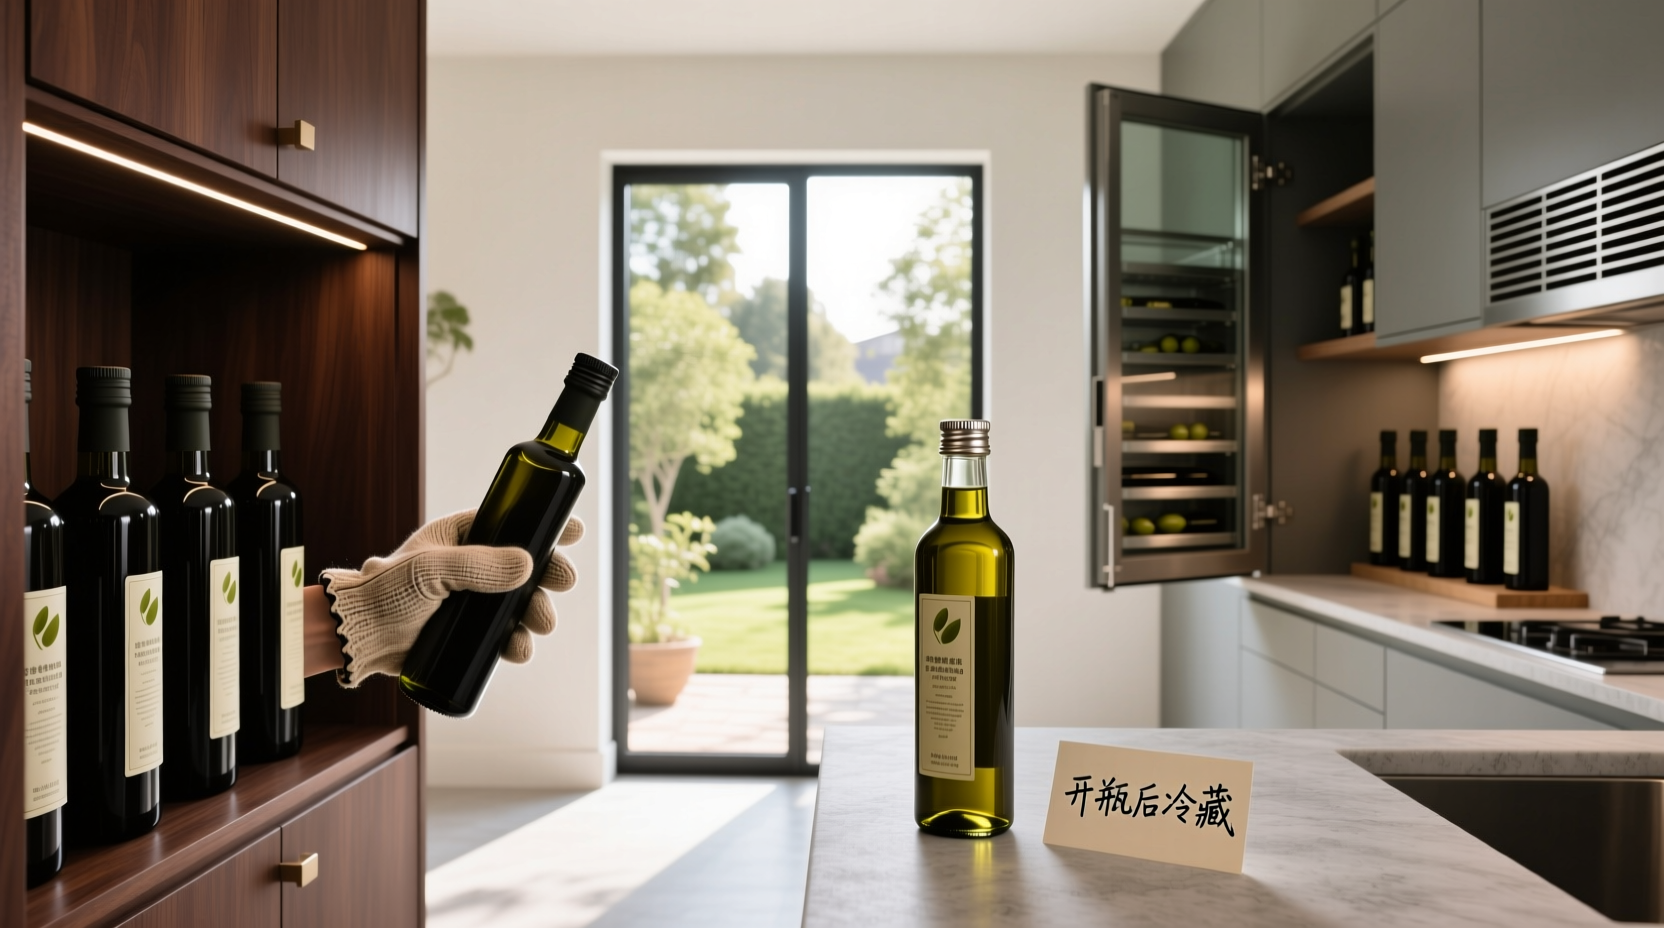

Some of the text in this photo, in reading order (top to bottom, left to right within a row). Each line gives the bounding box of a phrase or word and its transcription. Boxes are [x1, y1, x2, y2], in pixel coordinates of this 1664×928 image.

[1065, 775, 1235, 837] 开瓶后冷藏
